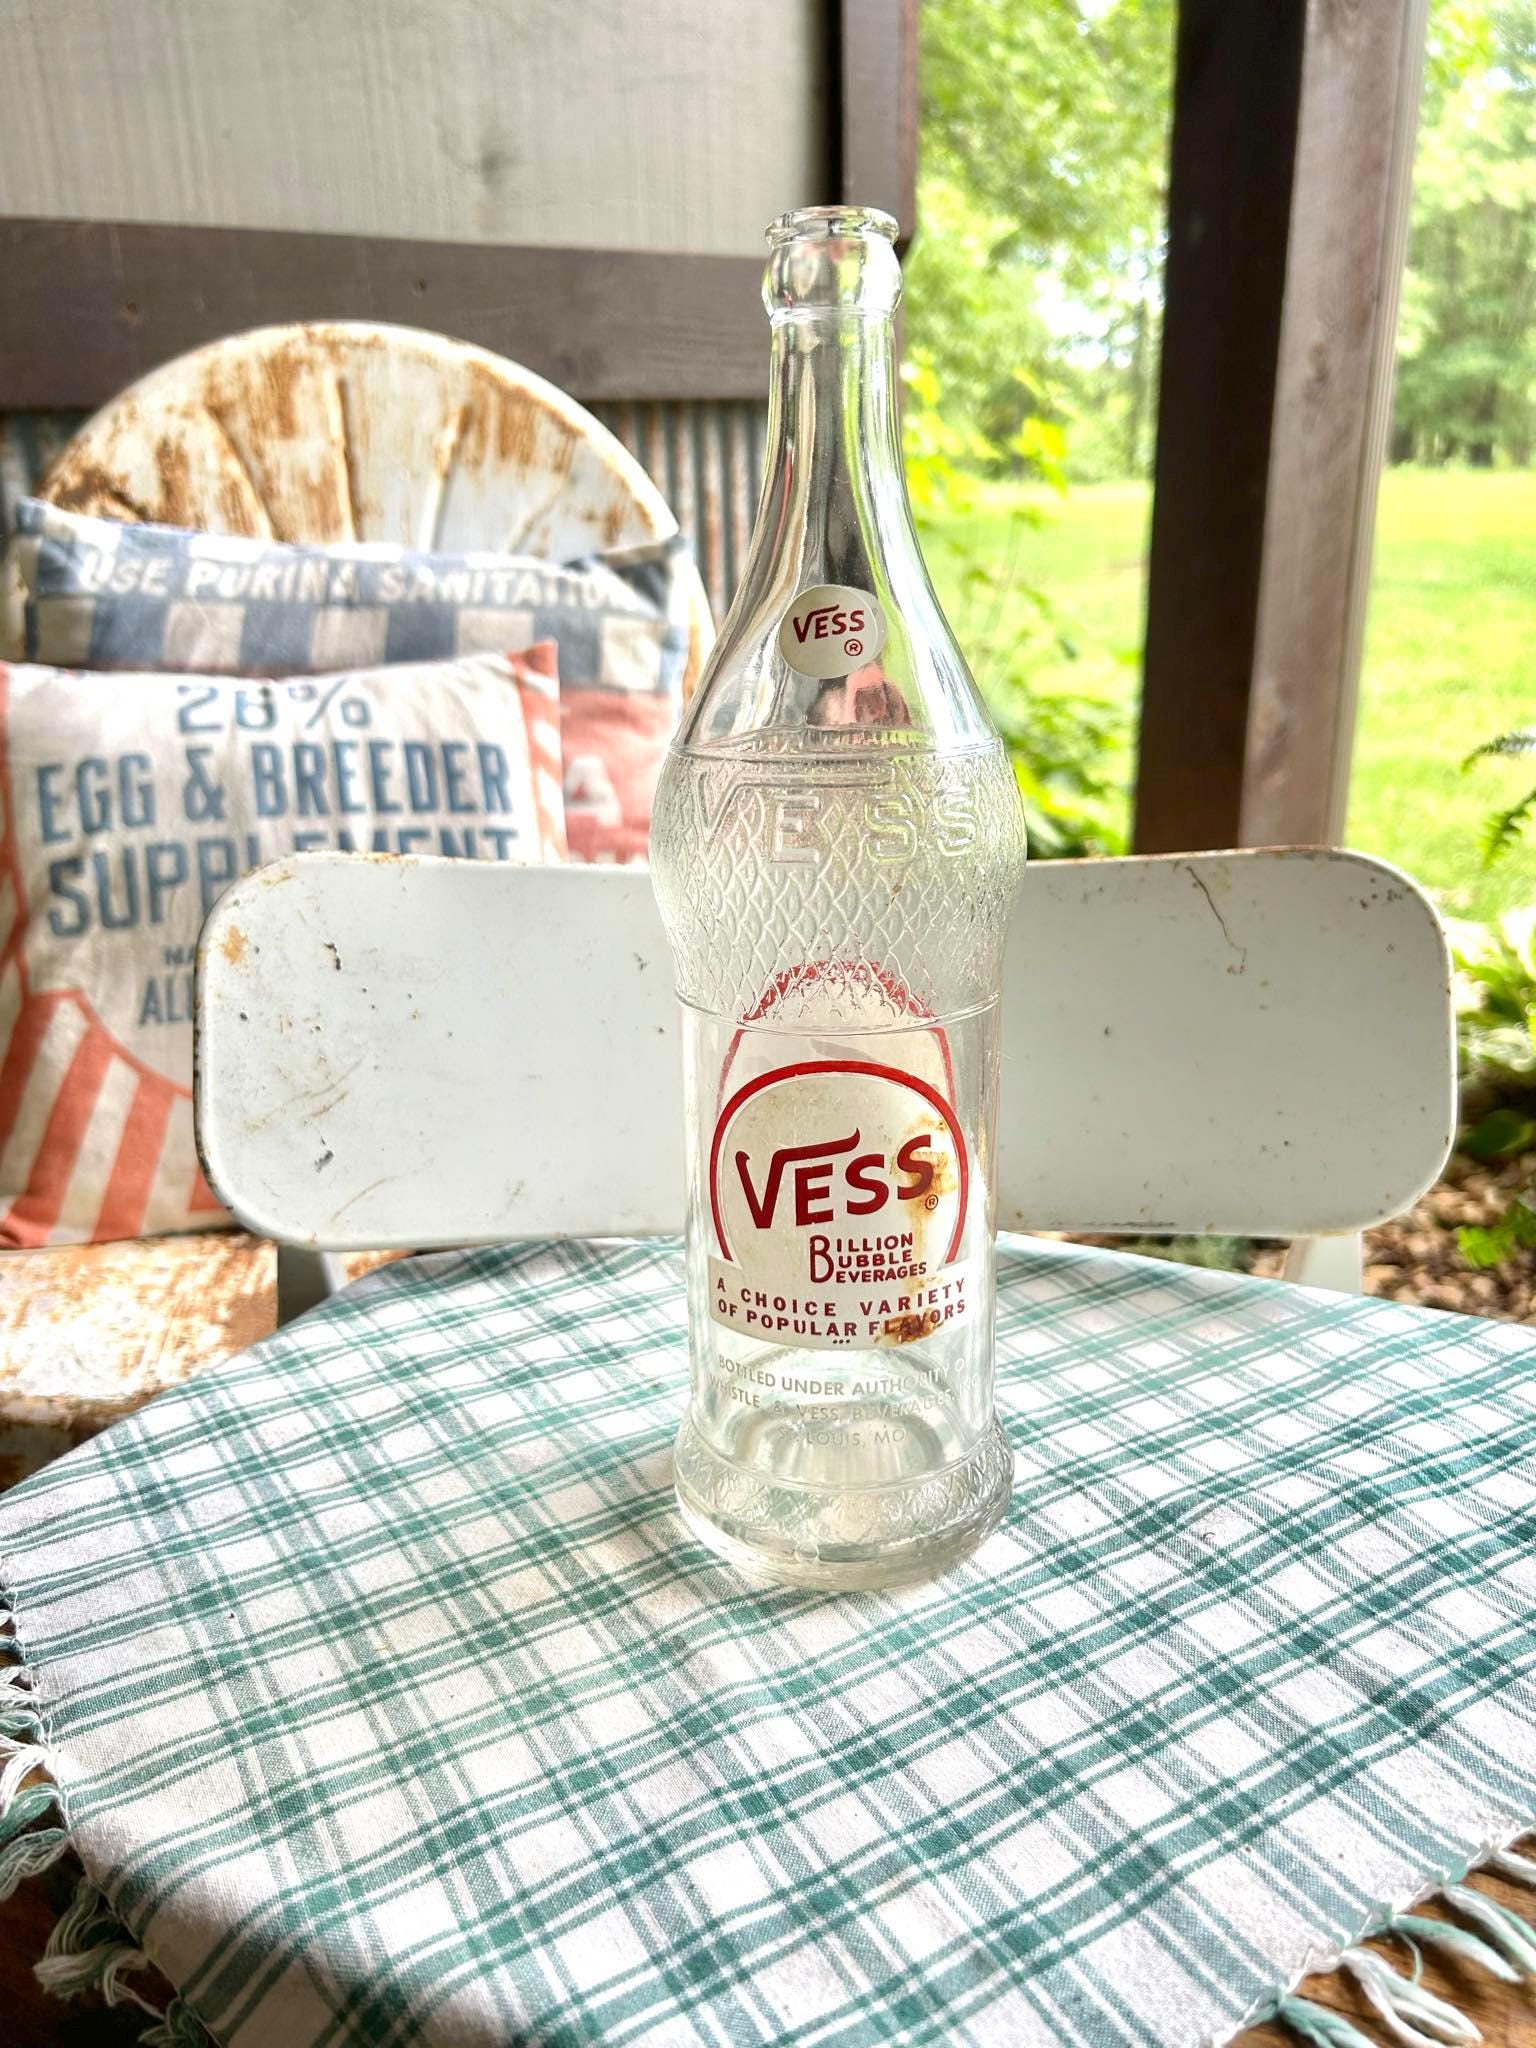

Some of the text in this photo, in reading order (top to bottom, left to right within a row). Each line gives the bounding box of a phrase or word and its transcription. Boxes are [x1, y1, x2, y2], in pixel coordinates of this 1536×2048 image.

[79, 552, 172, 595] USE
[792, 605, 865, 643] VESS
[36, 740, 513, 845] EGG & BREEDER
[694, 757, 979, 866] VESS
[735, 1127, 934, 1229] VESS
[717, 1277, 965, 1316] A CHOICE VARIETY
[718, 1299, 966, 1336] OF POPULAR FLAVORS
[719, 1354, 776, 1387] BOTTLED
[781, 1376, 845, 1395] UNDER
[852, 1364, 950, 1395] AUTHORITY
[709, 1373, 760, 1408] WHISTLE
[796, 1404, 840, 1421] VESS
